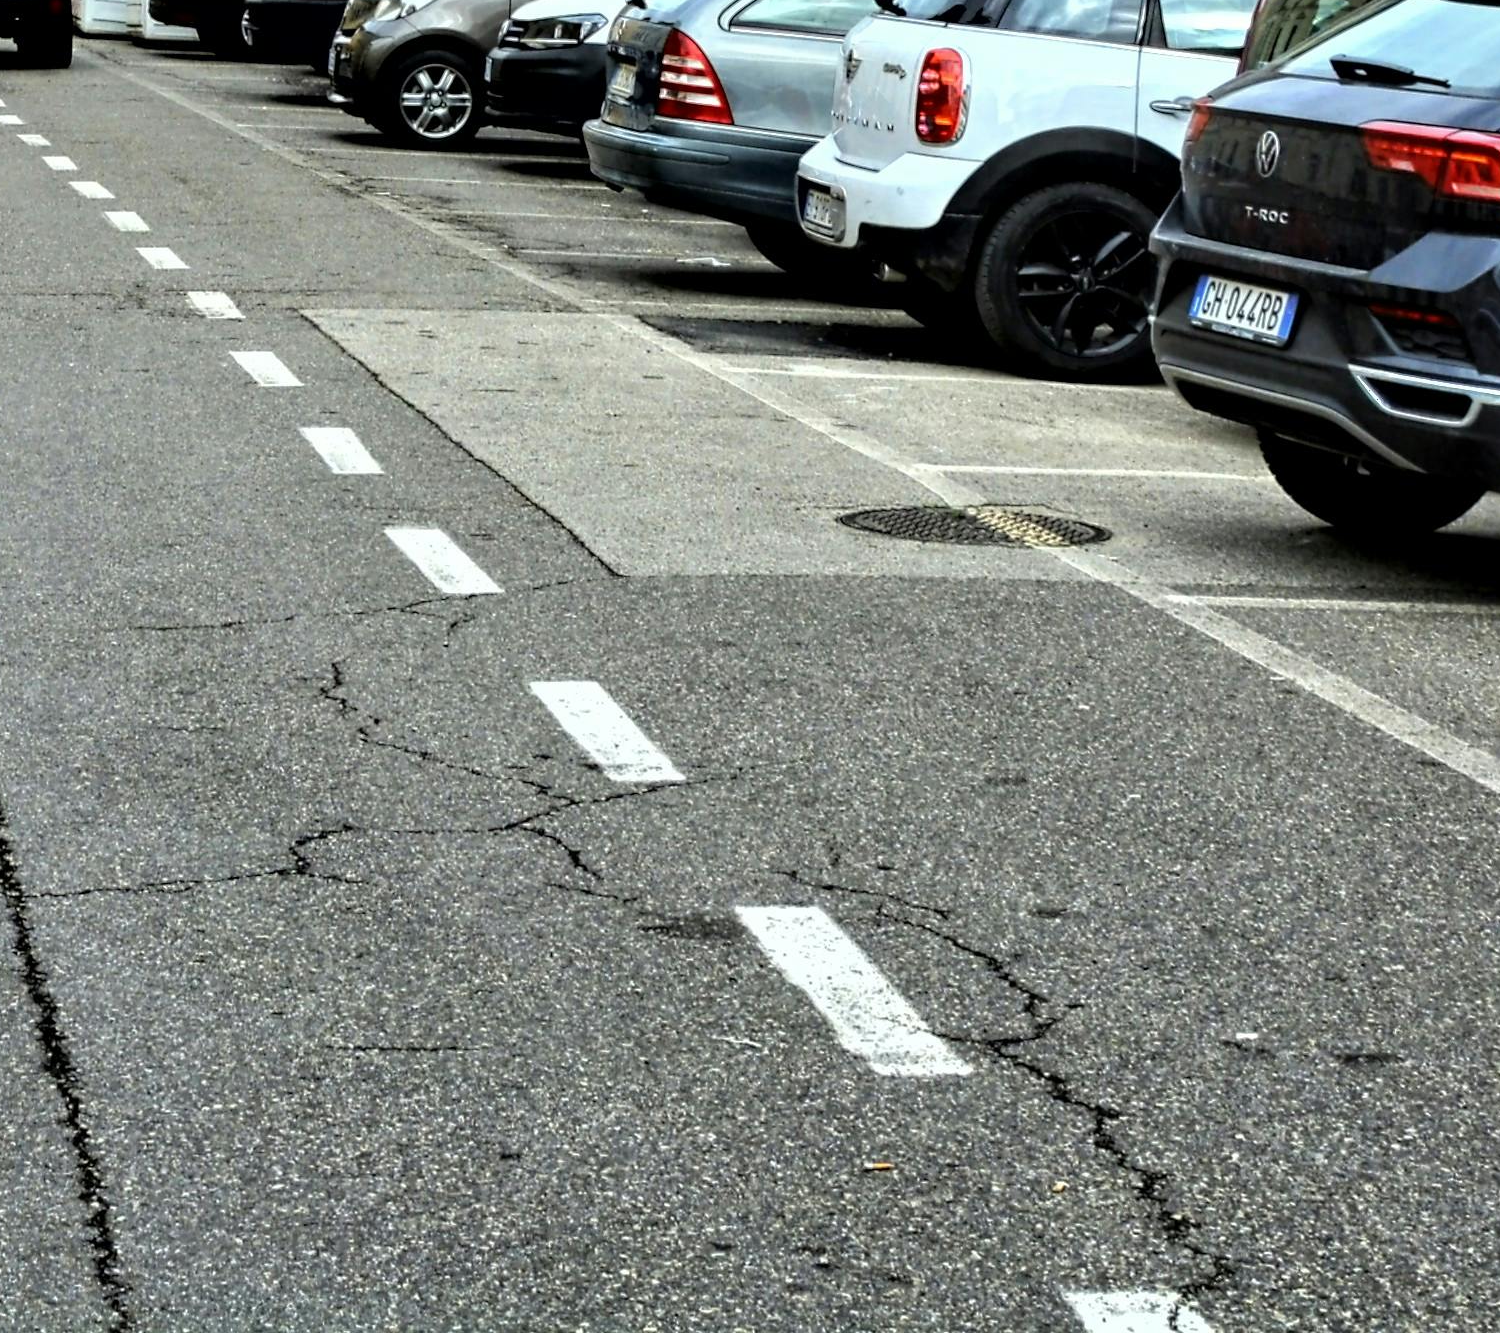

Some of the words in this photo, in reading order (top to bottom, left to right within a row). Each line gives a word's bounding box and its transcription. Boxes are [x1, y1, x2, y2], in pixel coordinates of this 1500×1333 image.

[1245, 205, 1289, 224] T-ROC
[1202, 280, 1227, 318] GH
[1226, 286, 1283, 330] 044RB
